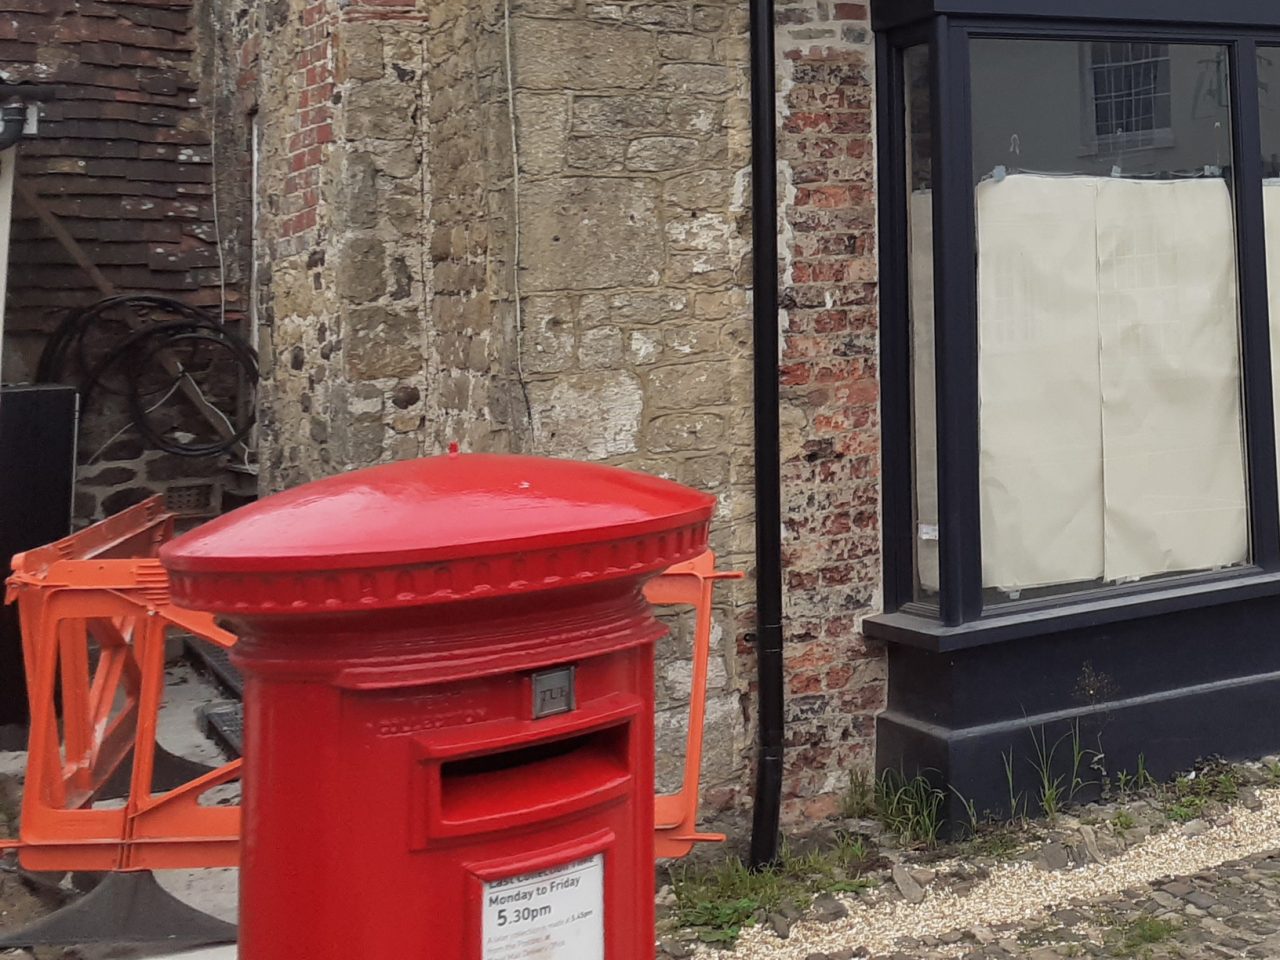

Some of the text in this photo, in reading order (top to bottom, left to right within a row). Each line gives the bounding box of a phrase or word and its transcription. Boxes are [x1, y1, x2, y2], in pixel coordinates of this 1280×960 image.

[488, 876, 581, 907] Monday to Friday
[497, 905, 551, 927] 5.30pm
